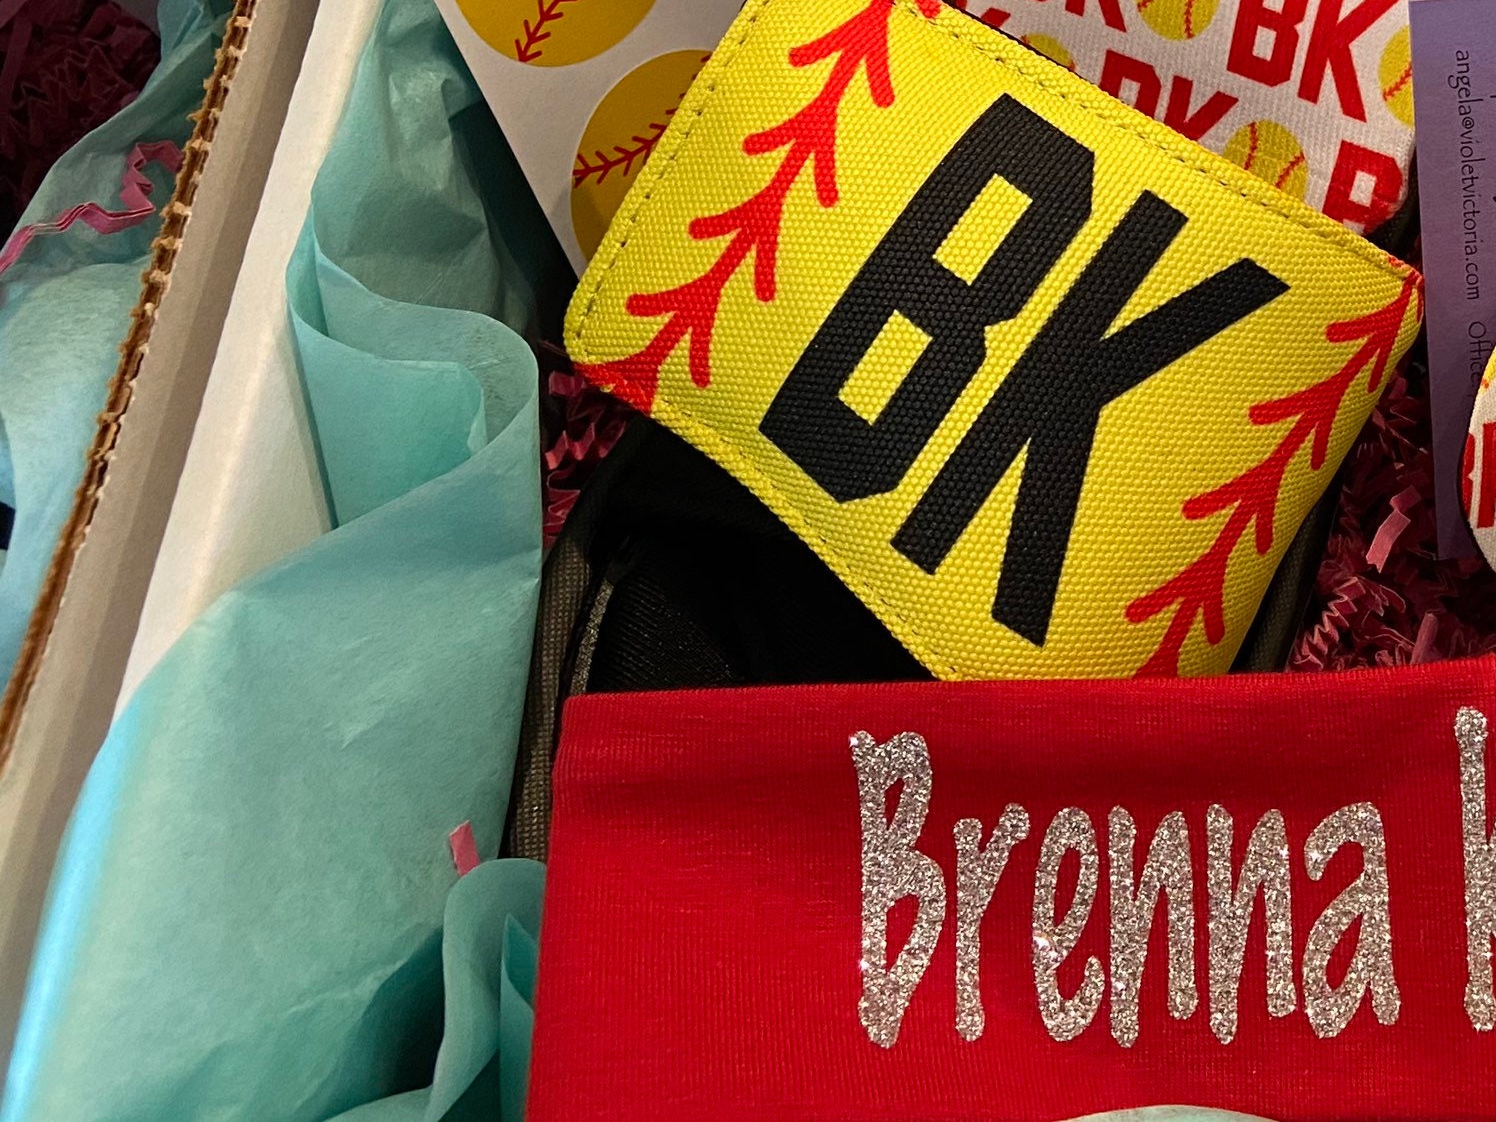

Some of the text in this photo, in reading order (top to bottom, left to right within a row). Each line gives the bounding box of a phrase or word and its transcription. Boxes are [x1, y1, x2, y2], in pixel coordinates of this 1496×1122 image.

[1447, 50, 1488, 301] angela@violetvictoria.com
[757, 93, 1292, 647] BK
[847, 729, 1400, 1050] Brenna
